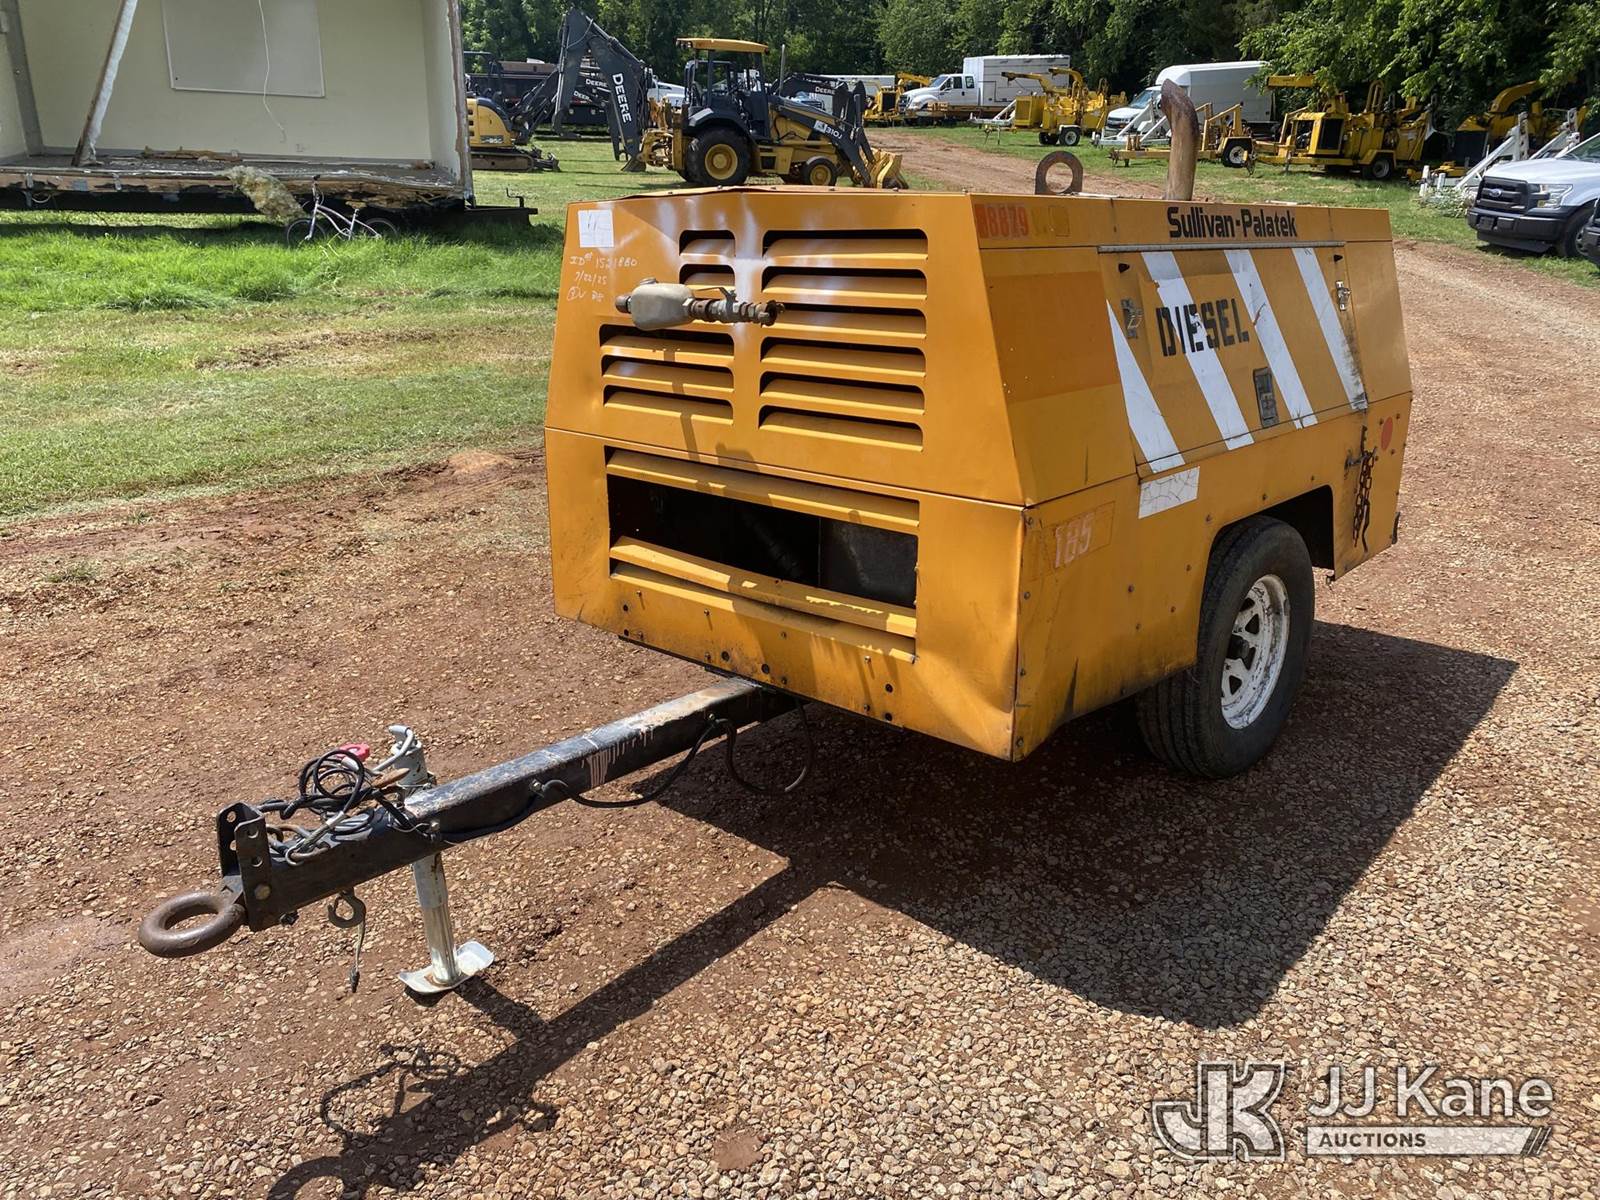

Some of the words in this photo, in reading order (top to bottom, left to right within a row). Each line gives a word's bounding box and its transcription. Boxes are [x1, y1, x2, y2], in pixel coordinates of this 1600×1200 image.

[585, 78, 609, 88] DEERE
[815, 86, 836, 95] DEERE
[612, 73, 632, 123] DEERE
[825, 125, 843, 140] 310J
[1167, 206, 1298, 241] Sullivan-Palatek
[1155, 298, 1250, 357] DIESEL
